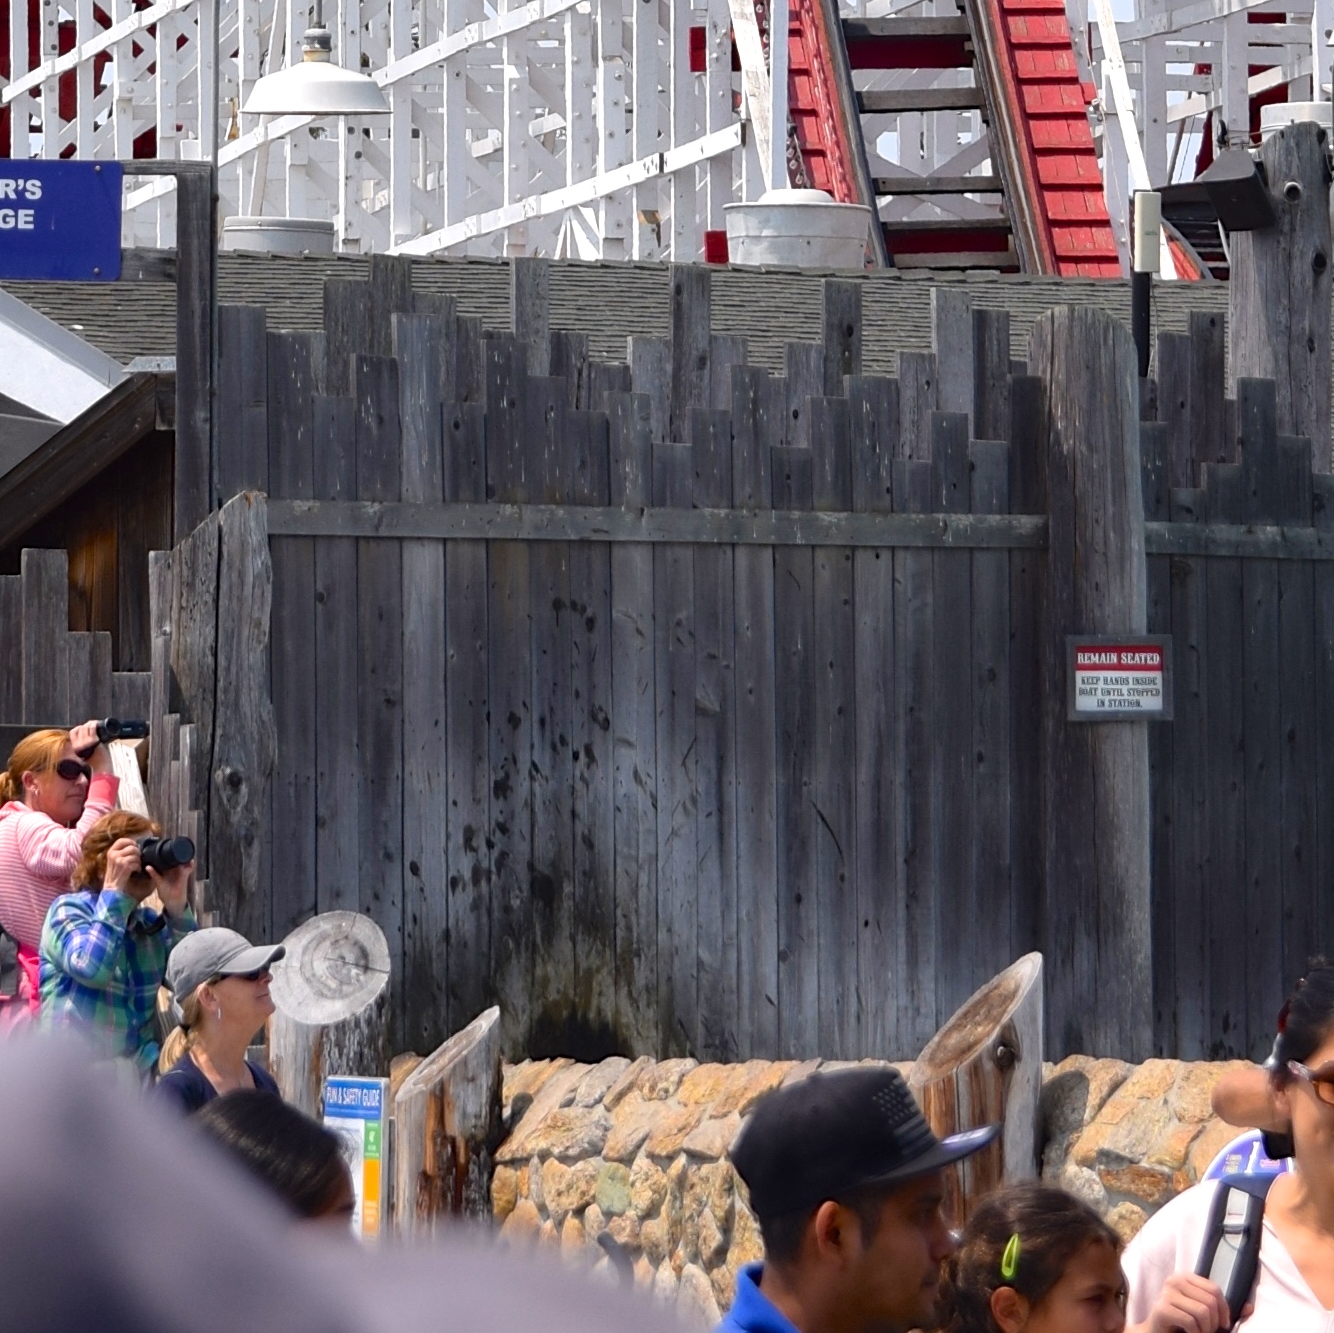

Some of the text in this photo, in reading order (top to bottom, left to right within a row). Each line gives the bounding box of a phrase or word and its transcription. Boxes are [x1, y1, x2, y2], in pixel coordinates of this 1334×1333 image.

[1077, 652, 1160, 664] REMAIN SEATED
[1081, 676, 1158, 686] KEEP HANDS INSIDE
[1078, 687, 1160, 697] BOAT UNTIL STOPPED
[1096, 698, 1143, 708] IN STATION.
[326, 1086, 337, 1104] FUN
[343, 1087, 361, 1106] SAFETY
[362, 1089, 380, 1107] GUIDE
